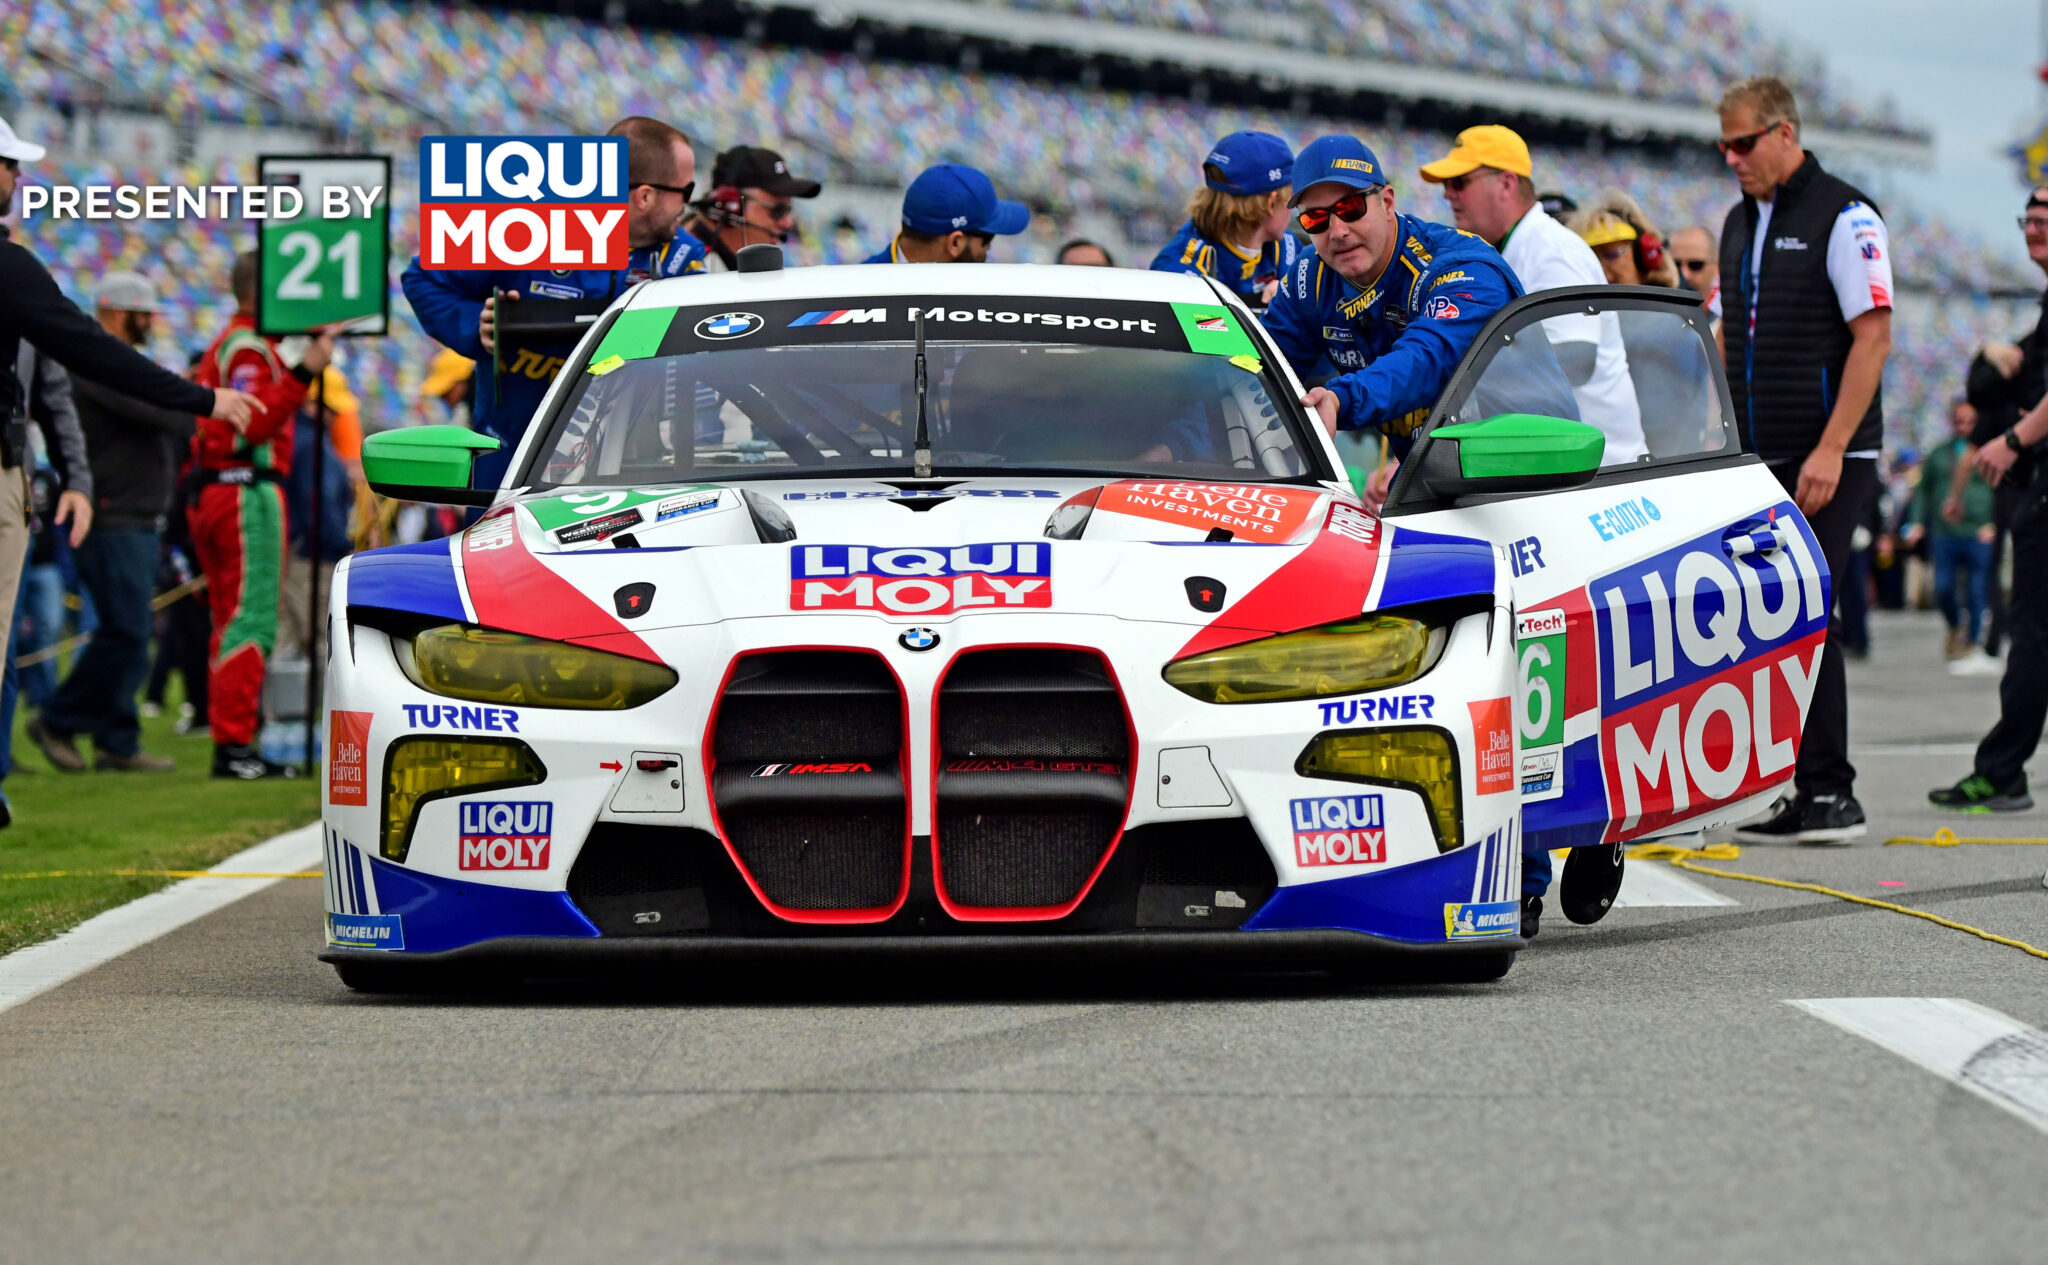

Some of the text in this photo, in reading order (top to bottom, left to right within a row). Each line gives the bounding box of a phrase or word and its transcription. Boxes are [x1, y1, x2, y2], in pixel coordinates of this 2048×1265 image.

[1345, 160, 1371, 171] TURNER
[276, 230, 361, 300] 21
[1299, 258, 1310, 301] sparco
[1344, 289, 1377, 320] TURNER
[1412, 270, 1430, 312] sparco
[908, 307, 1157, 334] Motorsport
[1426, 296, 1451, 319] VP
[1127, 495, 1275, 533] INVESTMENTS
[1588, 500, 1649, 542] E-CLOTH
[804, 544, 1038, 577] LIQUI
[803, 576, 1047, 613] MOLY
[1604, 514, 1825, 700] LIQUI
[402, 704, 520, 733] TURNER
[1318, 694, 1435, 726] TURNER
[1489, 730, 1510, 751] Belle
[1614, 642, 1825, 832] MOLY
[338, 743, 361, 763] Belle
[789, 762, 872, 775] IMSA
[1481, 751, 1510, 771] Haven
[333, 761, 361, 782] Haven
[1482, 772, 1511, 783] INVESTMENTS
[333, 786, 361, 795] INVESTMENTS
[464, 804, 548, 835] LIQUI
[1294, 797, 1380, 830] LIQUI
[463, 838, 549, 868] MOLY
[1298, 831, 1383, 865] MOLY
[336, 925, 391, 940] MICHELIN
